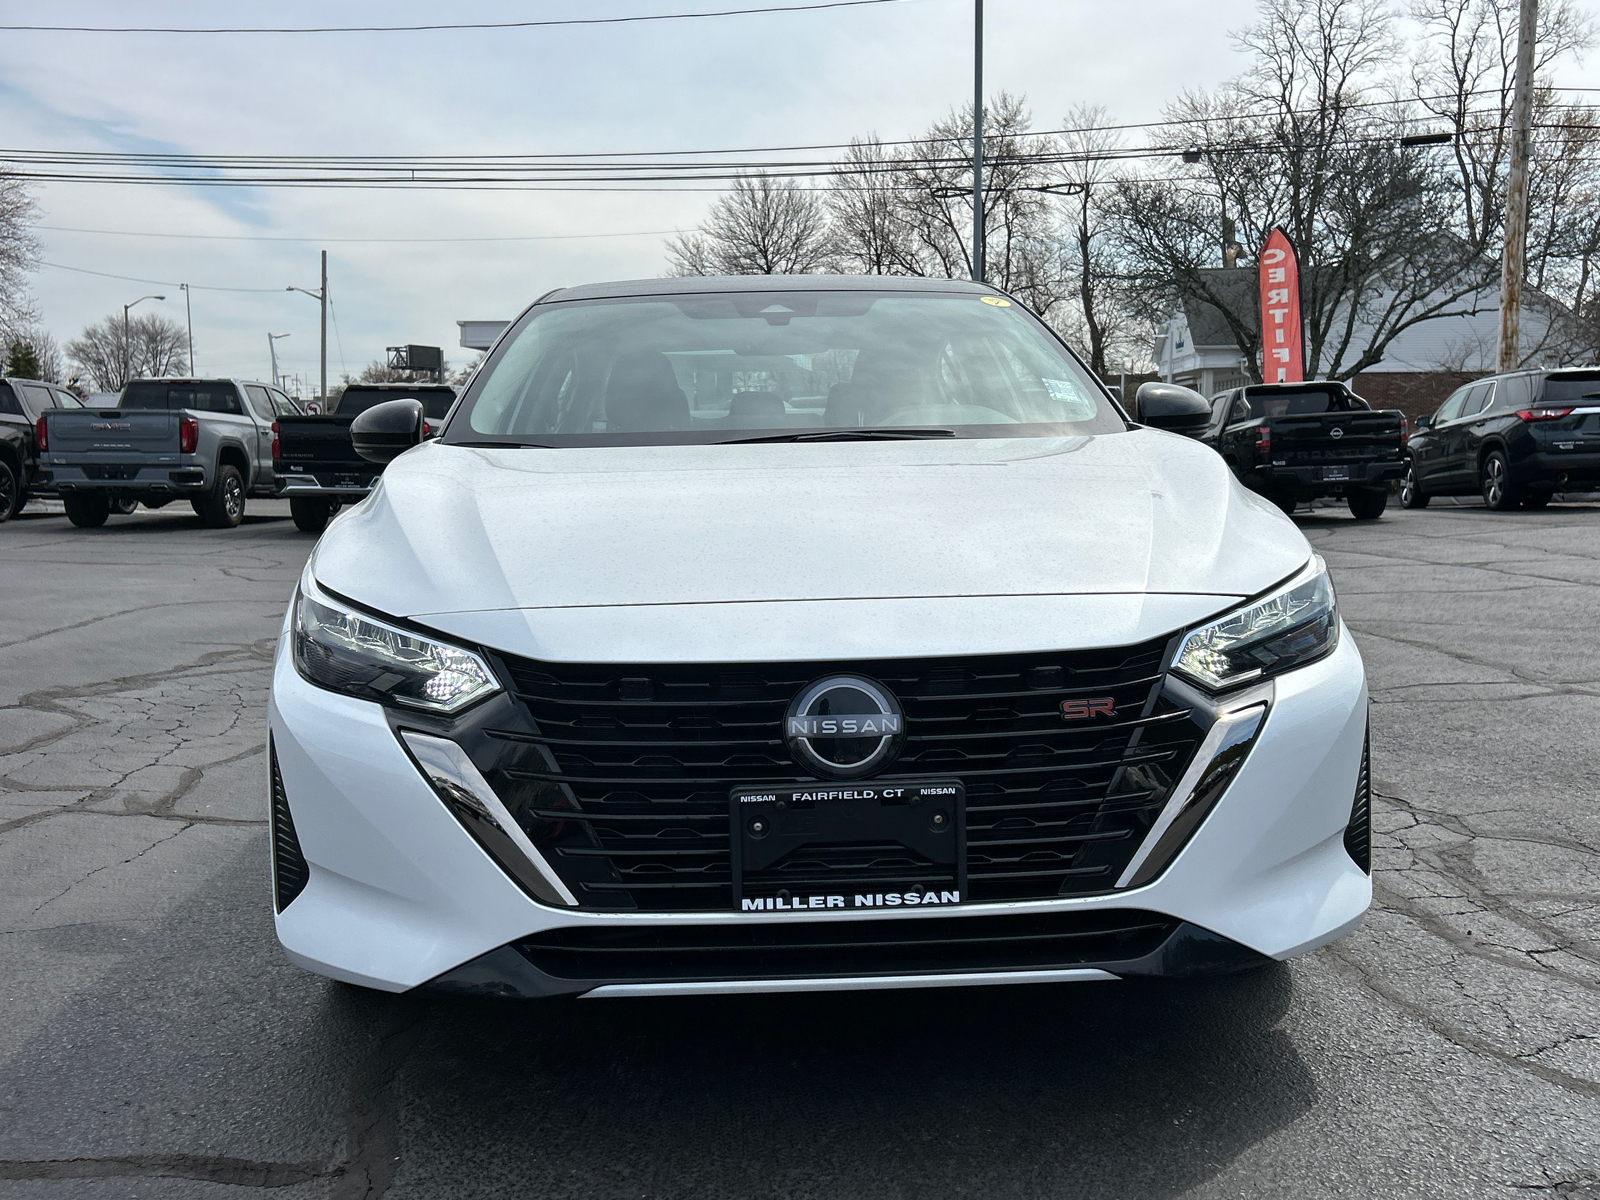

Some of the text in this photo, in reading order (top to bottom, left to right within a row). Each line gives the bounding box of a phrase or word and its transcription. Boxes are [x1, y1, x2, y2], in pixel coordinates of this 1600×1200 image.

[1062, 698, 1116, 719] SR
[791, 718, 898, 734] NISSAN
[740, 794, 776, 803] NISSAN
[792, 788, 905, 801] FAIRFIELD, CT
[920, 787, 956, 796] NISSAN
[741, 890, 960, 911] MILLER NISSAN
